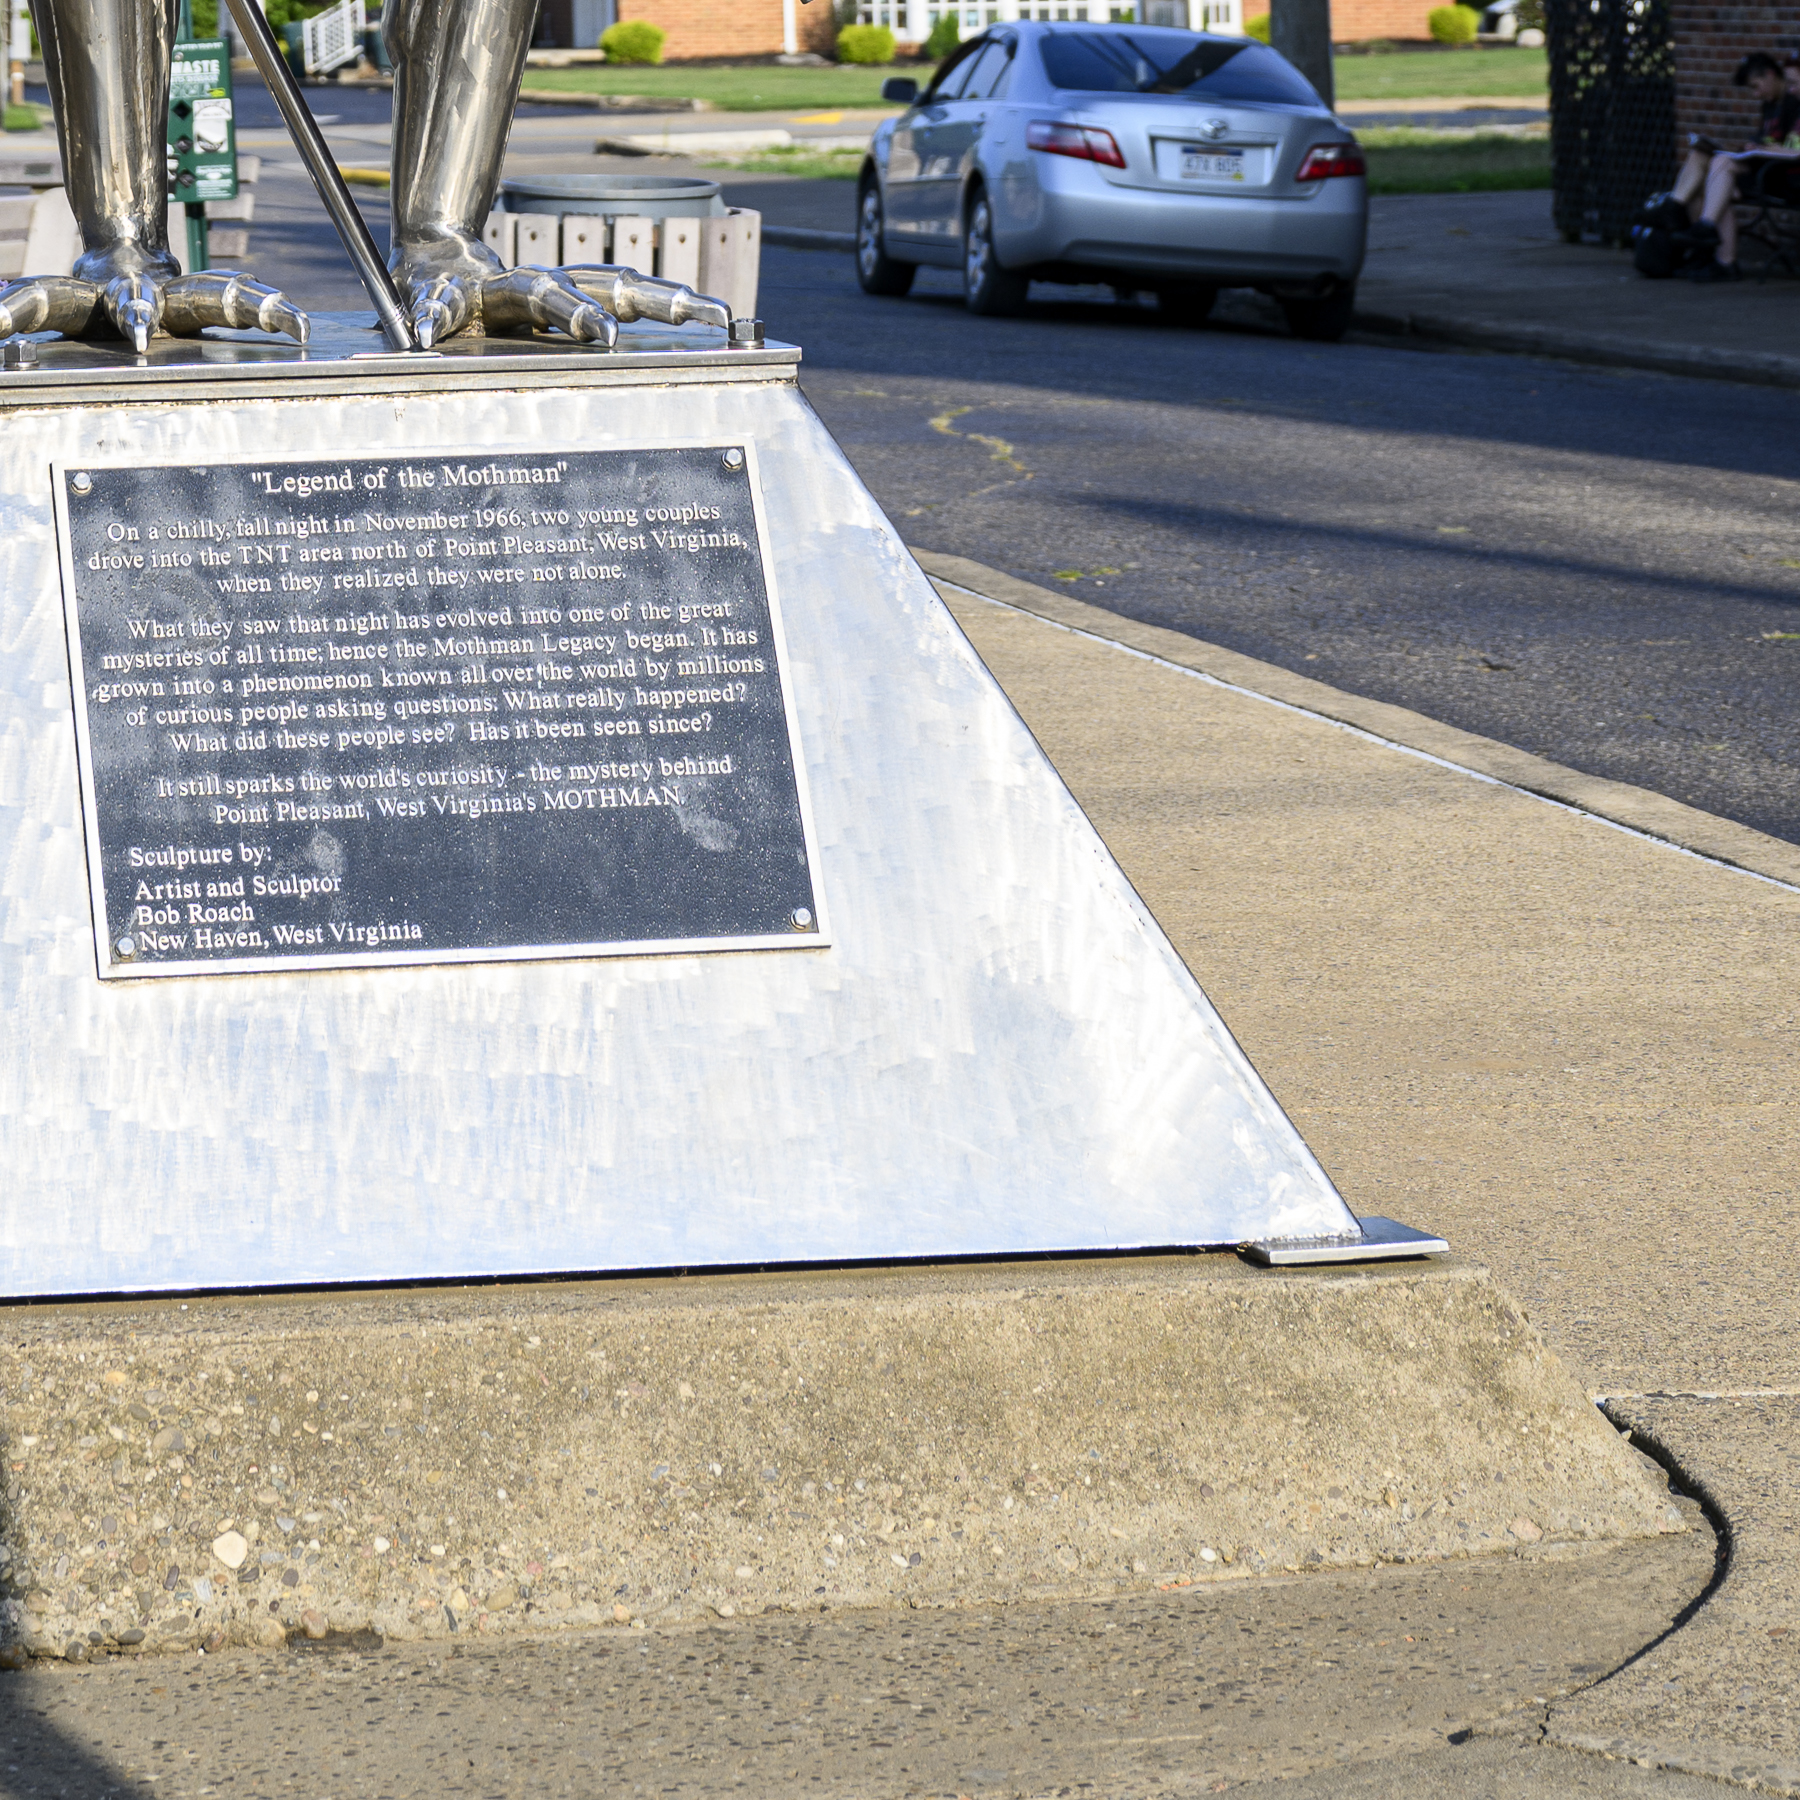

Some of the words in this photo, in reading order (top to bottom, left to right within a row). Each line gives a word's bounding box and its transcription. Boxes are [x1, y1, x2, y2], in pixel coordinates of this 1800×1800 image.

[251, 469, 355, 498] "Legend
[361, 467, 391, 489] of
[397, 466, 436, 488] the
[441, 461, 569, 486] Mothman"
[106, 522, 140, 541] On
[147, 526, 160, 540] a
[165, 518, 232, 544] chilly,
[235, 517, 271, 537] fall
[274, 515, 330, 540] night
[332, 514, 357, 533] in
[364, 510, 469, 532] November
[473, 508, 527, 533] 1966,
[529, 506, 570, 526] two
[576, 509, 639, 529] young
[643, 501, 722, 527] couples
[86, 550, 145, 570] drove
[149, 548, 193, 567] into
[199, 547, 232, 566] the
[236, 544, 293, 564] TNT
[298, 548, 343, 562] area
[349, 540, 408, 560] north
[413, 539, 438, 558] of
[444, 537, 499, 557] Point
[501, 534, 595, 559] Pleasant,
[597, 532, 647, 551] West
[651, 528, 749, 553] Virginia,
[215, 574, 273, 593] when
[280, 572, 325, 595] they
[331, 569, 420, 589] realized
[426, 567, 471, 589] they
[476, 570, 525, 583] were
[530, 564, 564, 581] not
[567, 561, 627, 580] alone.
[126, 619, 185, 640] What
[189, 617, 235, 641] they
[242, 621, 282, 636] saw
[288, 613, 330, 634] that
[333, 611, 390, 636] night
[393, 610, 431, 630] has
[434, 607, 513, 628] evolved
[519, 605, 562, 625] into
[567, 609, 605, 623] one
[609, 602, 634, 622] of
[638, 601, 672, 621] the
[676, 598, 733, 623] great
[101, 646, 205, 673] mysteries
[207, 645, 231, 665] of
[234, 644, 264, 664] all
[327, 639, 389, 660] hence
[393, 638, 427, 658] the
[432, 634, 535, 656] Mothman
[540, 631, 619, 656] Legacy
[699, 627, 718, 646] It
[720, 625, 759, 645] has
[96, 682, 166, 702] grown
[172, 675, 215, 695] into
[221, 680, 234, 693] a
[240, 669, 374, 697] phenomenon
[379, 666, 453, 687] known
[459, 664, 487, 684] all
[490, 668, 536, 683] over
[539, 661, 574, 681] the
[578, 659, 638, 679] world
[643, 657, 673, 681] by
[675, 654, 765, 675] millions
[125, 707, 149, 726] of
[154, 703, 234, 724] curious
[239, 700, 310, 725] people
[313, 697, 387, 722] asking
[503, 690, 562, 711] What
[565, 688, 627, 712] really
[634, 683, 748, 709] happened?
[170, 732, 228, 753] What
[234, 731, 268, 750] did
[274, 728, 331, 748] these
[336, 725, 407, 750] people
[410, 723, 457, 743] see?
[467, 721, 510, 741] Has
[513, 720, 530, 739] it
[534, 718, 586, 738] been
[593, 721, 641, 736] seen
[646, 713, 714, 733] since?
[156, 777, 174, 797] It
[177, 775, 222, 796] still
[224, 772, 296, 798] sparks
[299, 771, 333, 791] the
[337, 768, 411, 789] world's
[414, 764, 509, 790] curiosity
[529, 761, 563, 782] the
[567, 758, 655, 784] mystery
[658, 755, 733, 776] behind
[213, 803, 269, 824] Point
[275, 798, 371, 825] Pleasant,
[375, 796, 427, 817] West
[431, 792, 537, 819] Virginia's
[129, 843, 234, 871] Sculpture
[239, 841, 273, 866] by:
[133, 879, 202, 901] Artist
[205, 877, 245, 897] and
[251, 873, 343, 900] Sculptor
[135, 904, 181, 926] Bob
[186, 901, 255, 923] Roach
[139, 930, 188, 951] New
[194, 926, 270, 953] Haven,
[272, 924, 324, 945] West
[330, 919, 423, 947] Virginia
